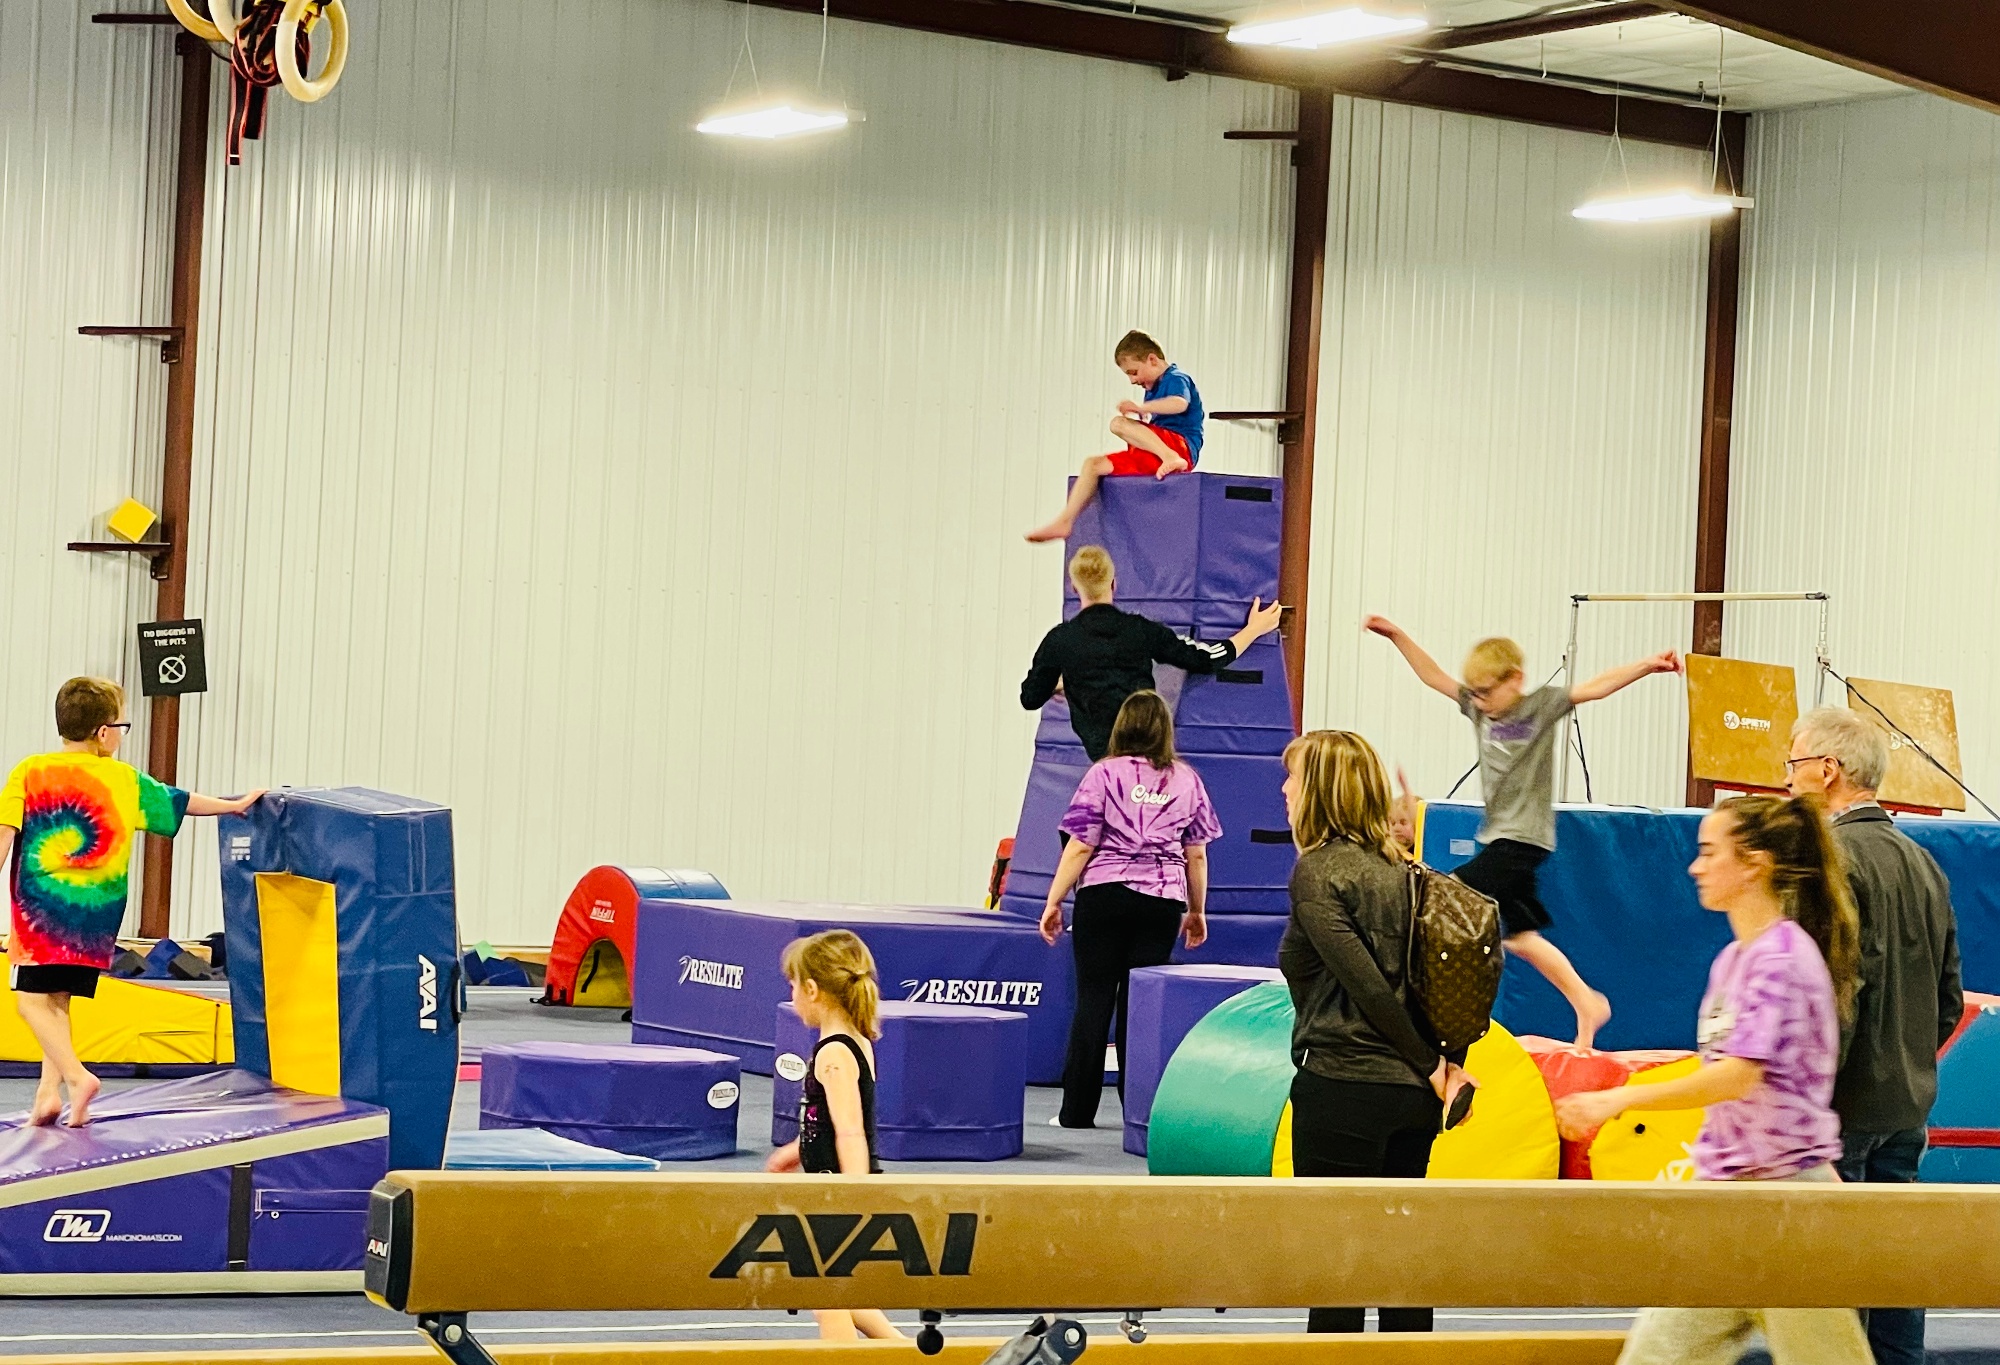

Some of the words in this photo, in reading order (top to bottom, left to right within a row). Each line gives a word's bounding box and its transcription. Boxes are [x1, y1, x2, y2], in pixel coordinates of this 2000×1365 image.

[154, 639, 169, 647] THE
[169, 637, 187, 646] PITS
[1131, 784, 1170, 805] Crew
[688, 958, 744, 990] RESILITE
[925, 978, 1043, 1006] RESILITE
